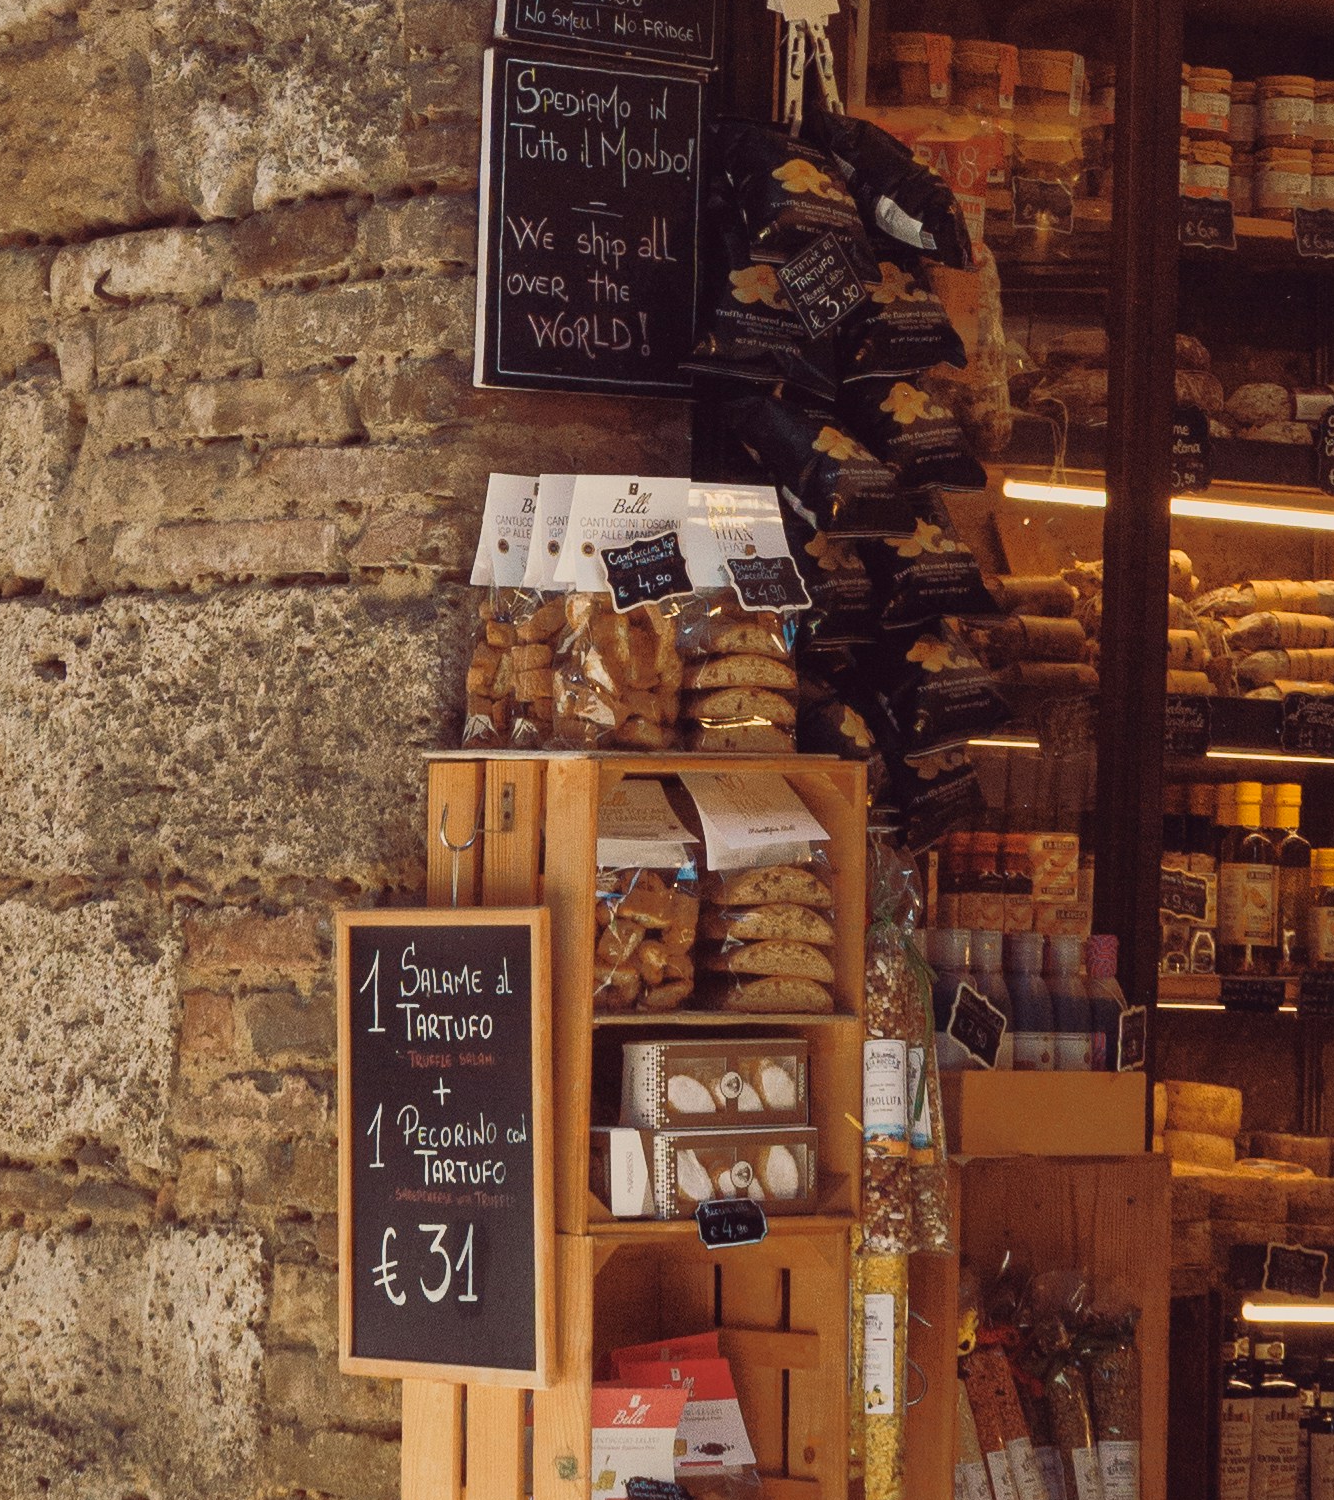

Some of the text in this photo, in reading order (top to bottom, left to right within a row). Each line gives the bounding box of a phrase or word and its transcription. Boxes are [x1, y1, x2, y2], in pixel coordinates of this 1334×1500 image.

[577, 220, 626, 271] ship
[638, 216, 677, 262] all
[588, 270, 630, 303] the
[790, 255, 835, 291] TARTUFO
[495, 515, 534, 527] CANTUCC
[613, 492, 653, 515] Belli
[580, 516, 640, 528] CANTUCCINI
[642, 519, 681, 531] TOSCANI
[637, 574, 672, 594] 4,90
[359, 949, 386, 1032] 1
[495, 957, 513, 994] al
[396, 1003, 493, 1042] TARTUFO
[367, 1102, 385, 1168] 1
[413, 1149, 507, 1186] TARTUFO
[371, 1222, 478, 1306] € 31
[613, 1404, 651, 1425] Belli
